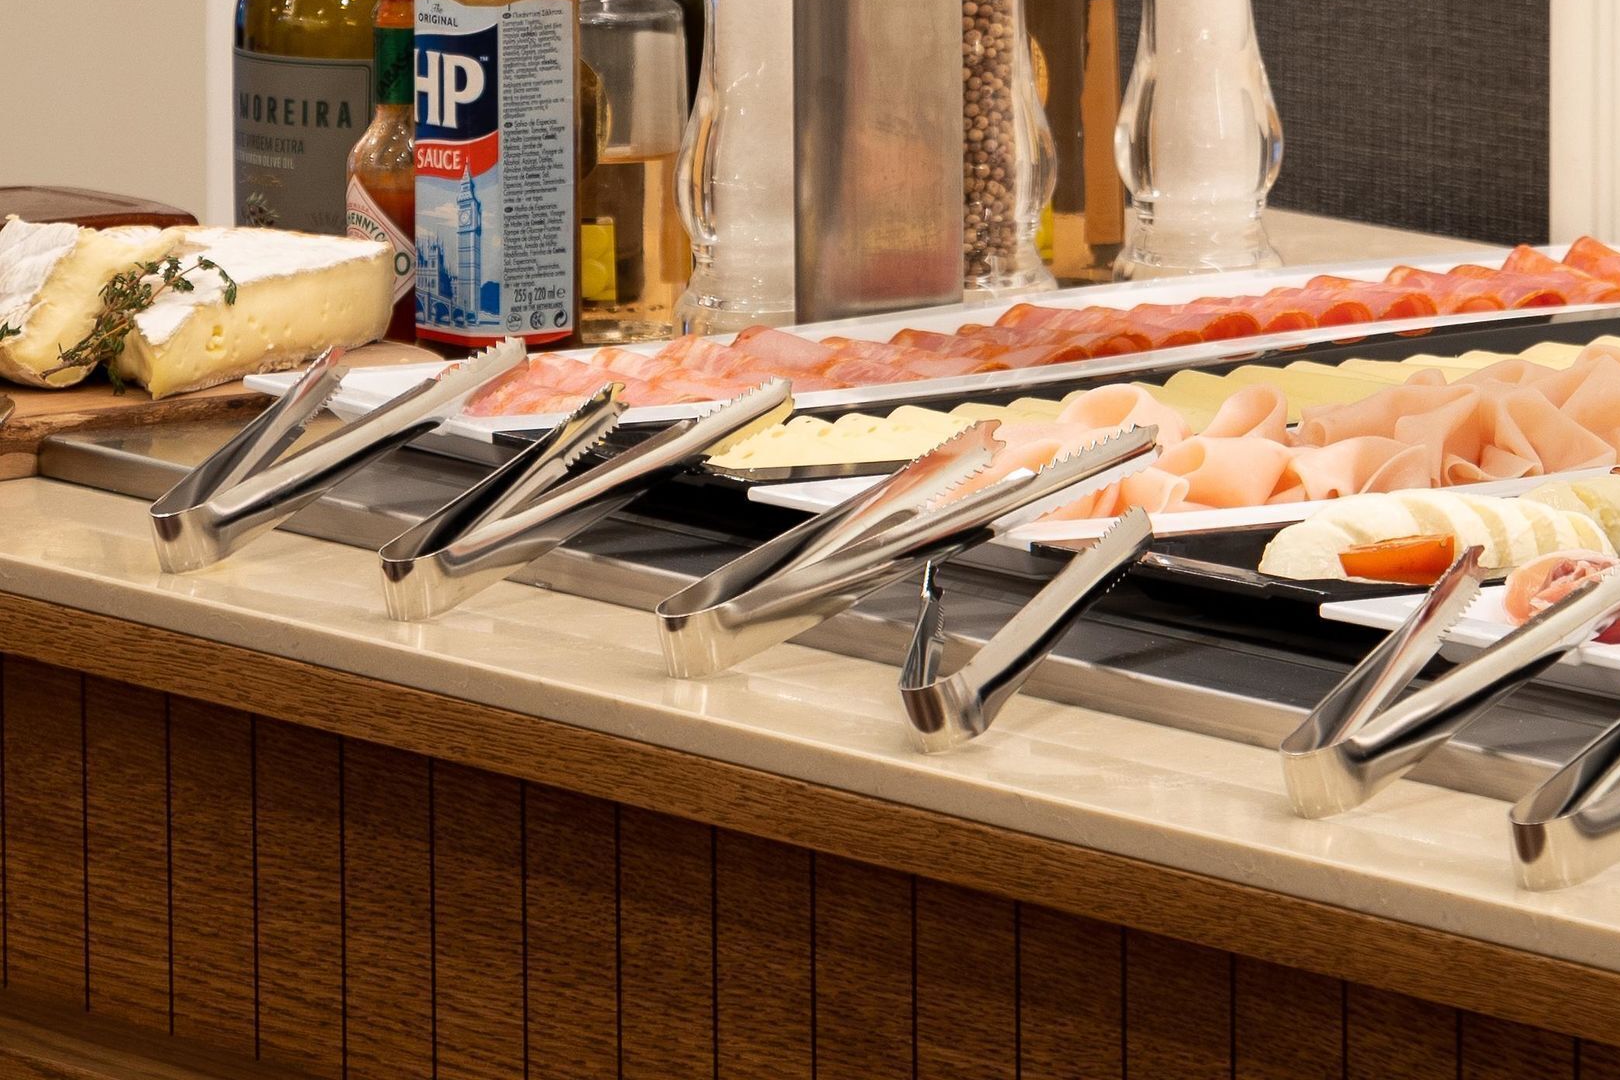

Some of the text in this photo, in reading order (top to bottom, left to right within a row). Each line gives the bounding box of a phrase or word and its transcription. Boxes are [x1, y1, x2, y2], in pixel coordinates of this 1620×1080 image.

[418, 12, 459, 28] ORIGINAL
[414, 48, 485, 129] HP
[274, 138, 305, 154] EXTRA
[416, 147, 462, 171] SAUCE
[514, 288, 527, 303] 255
[533, 287, 546, 301] 220
[548, 285, 555, 299] ml
